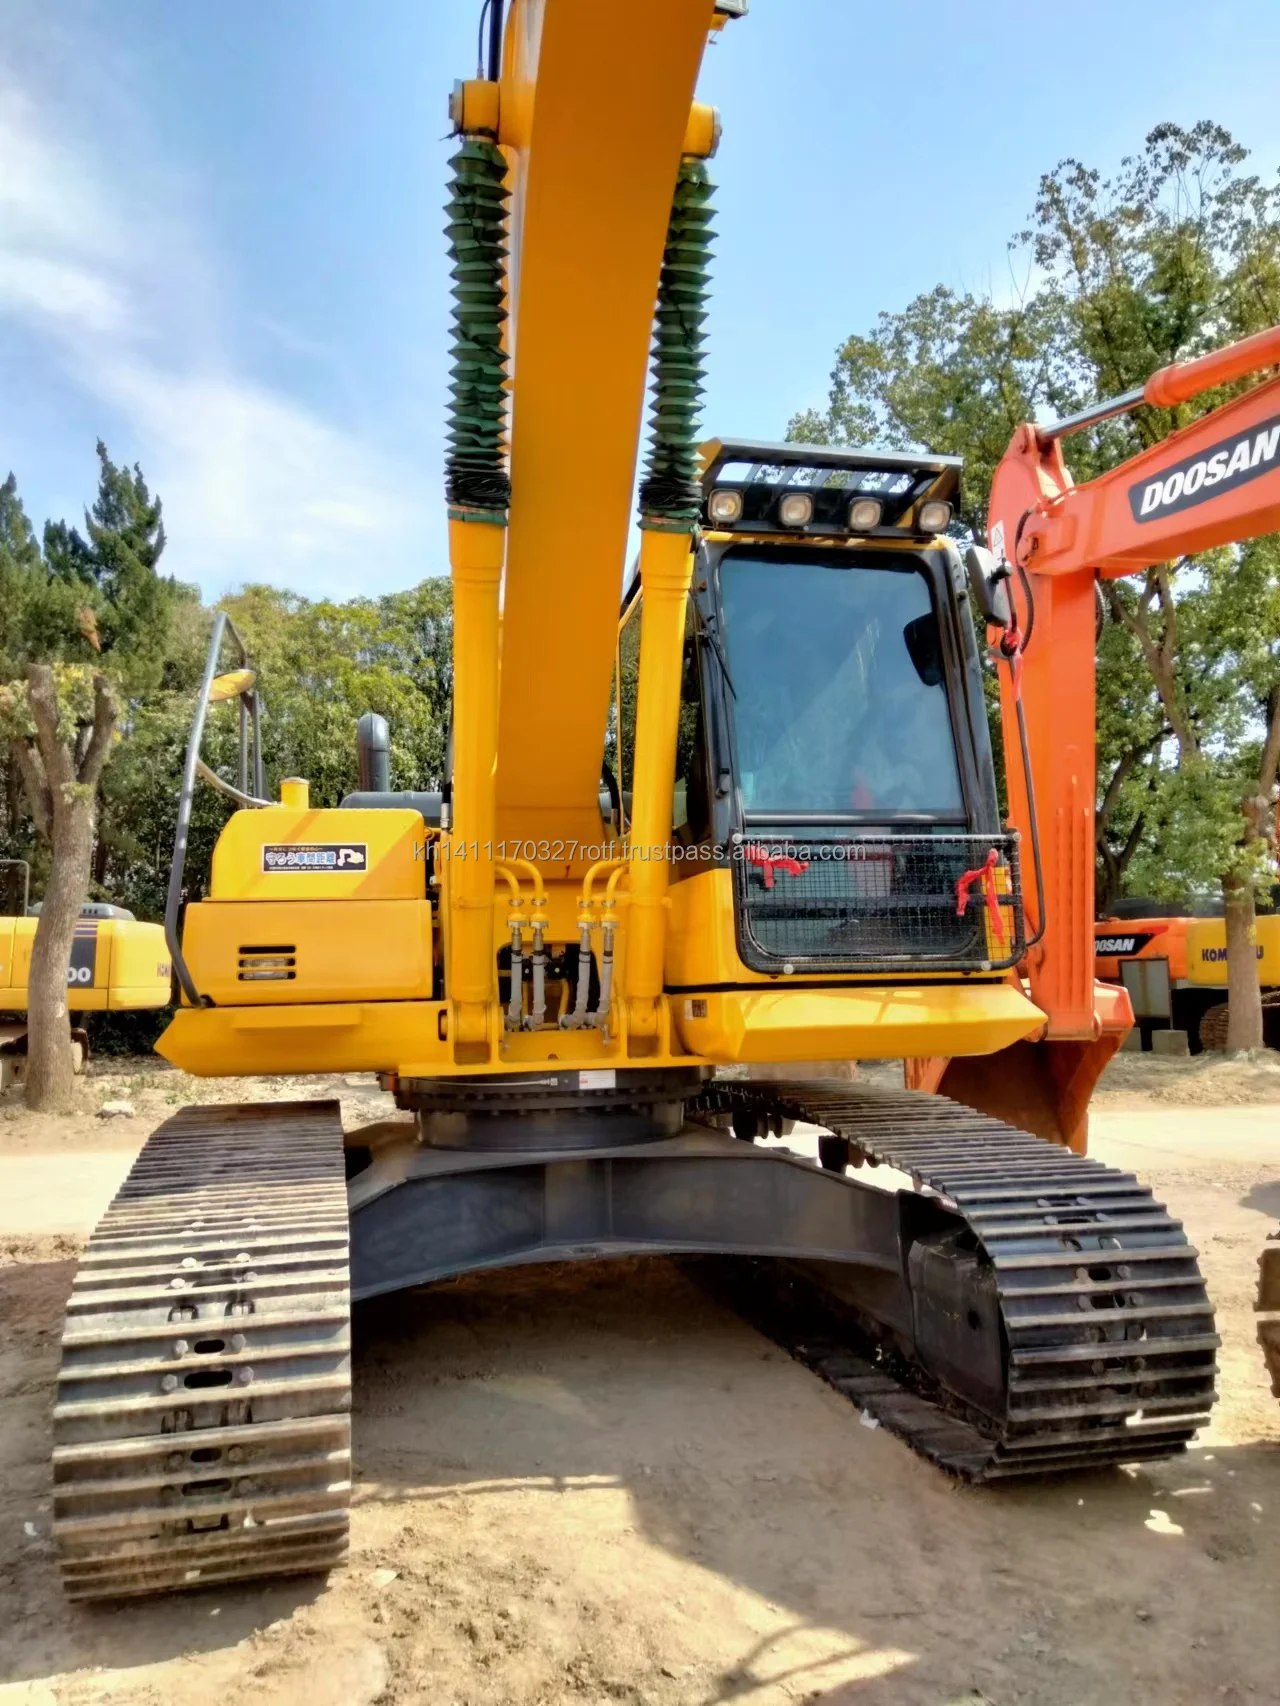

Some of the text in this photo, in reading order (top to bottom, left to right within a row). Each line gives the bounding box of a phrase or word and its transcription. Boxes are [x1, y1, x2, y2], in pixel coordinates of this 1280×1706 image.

[1140, 424, 1280, 516] DOOSAN
[1095, 938, 1136, 952] OOSAN
[1202, 945, 1264, 962] KOMU
